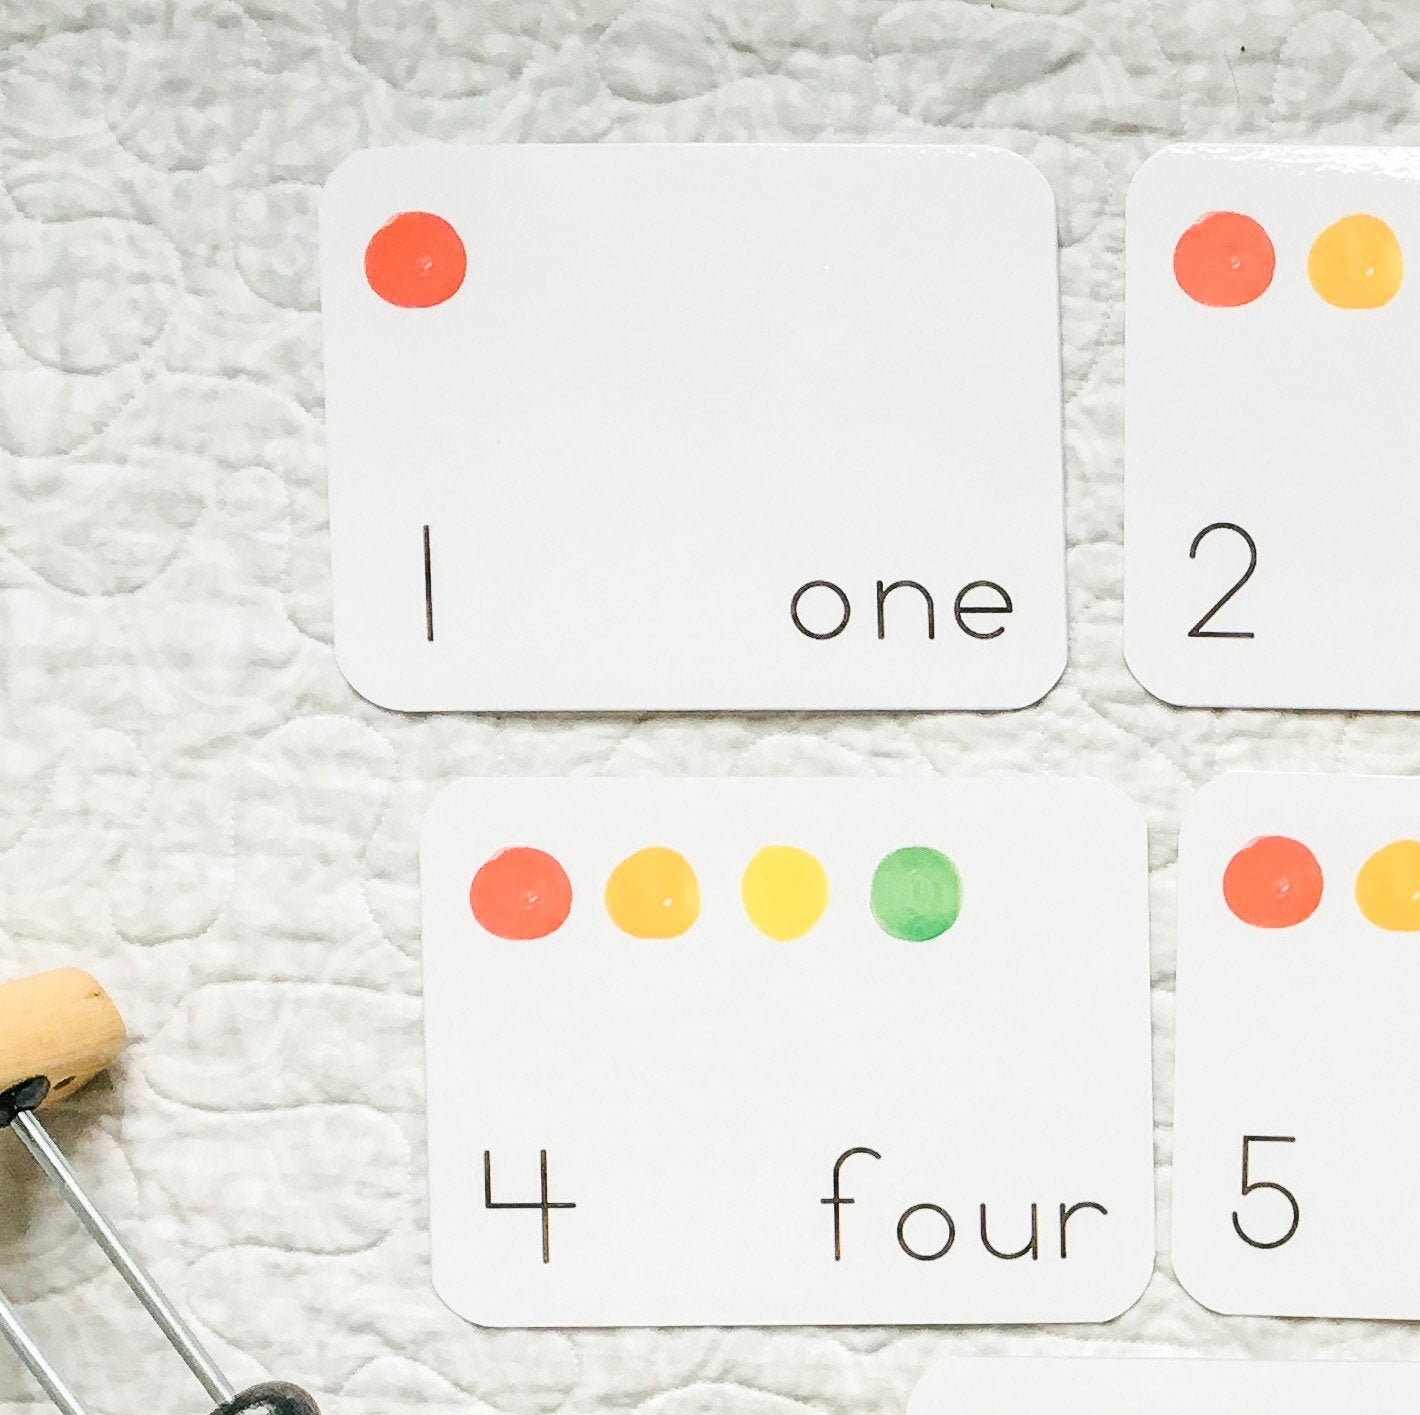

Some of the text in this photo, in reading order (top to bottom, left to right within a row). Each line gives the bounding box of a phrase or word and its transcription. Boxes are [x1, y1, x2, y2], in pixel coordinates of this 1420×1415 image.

[419, 522, 1014, 645] 1 one
[1187, 521, 1258, 640] 2
[483, 1146, 1109, 1265] 4 four
[1231, 1134, 1300, 1250] 5
